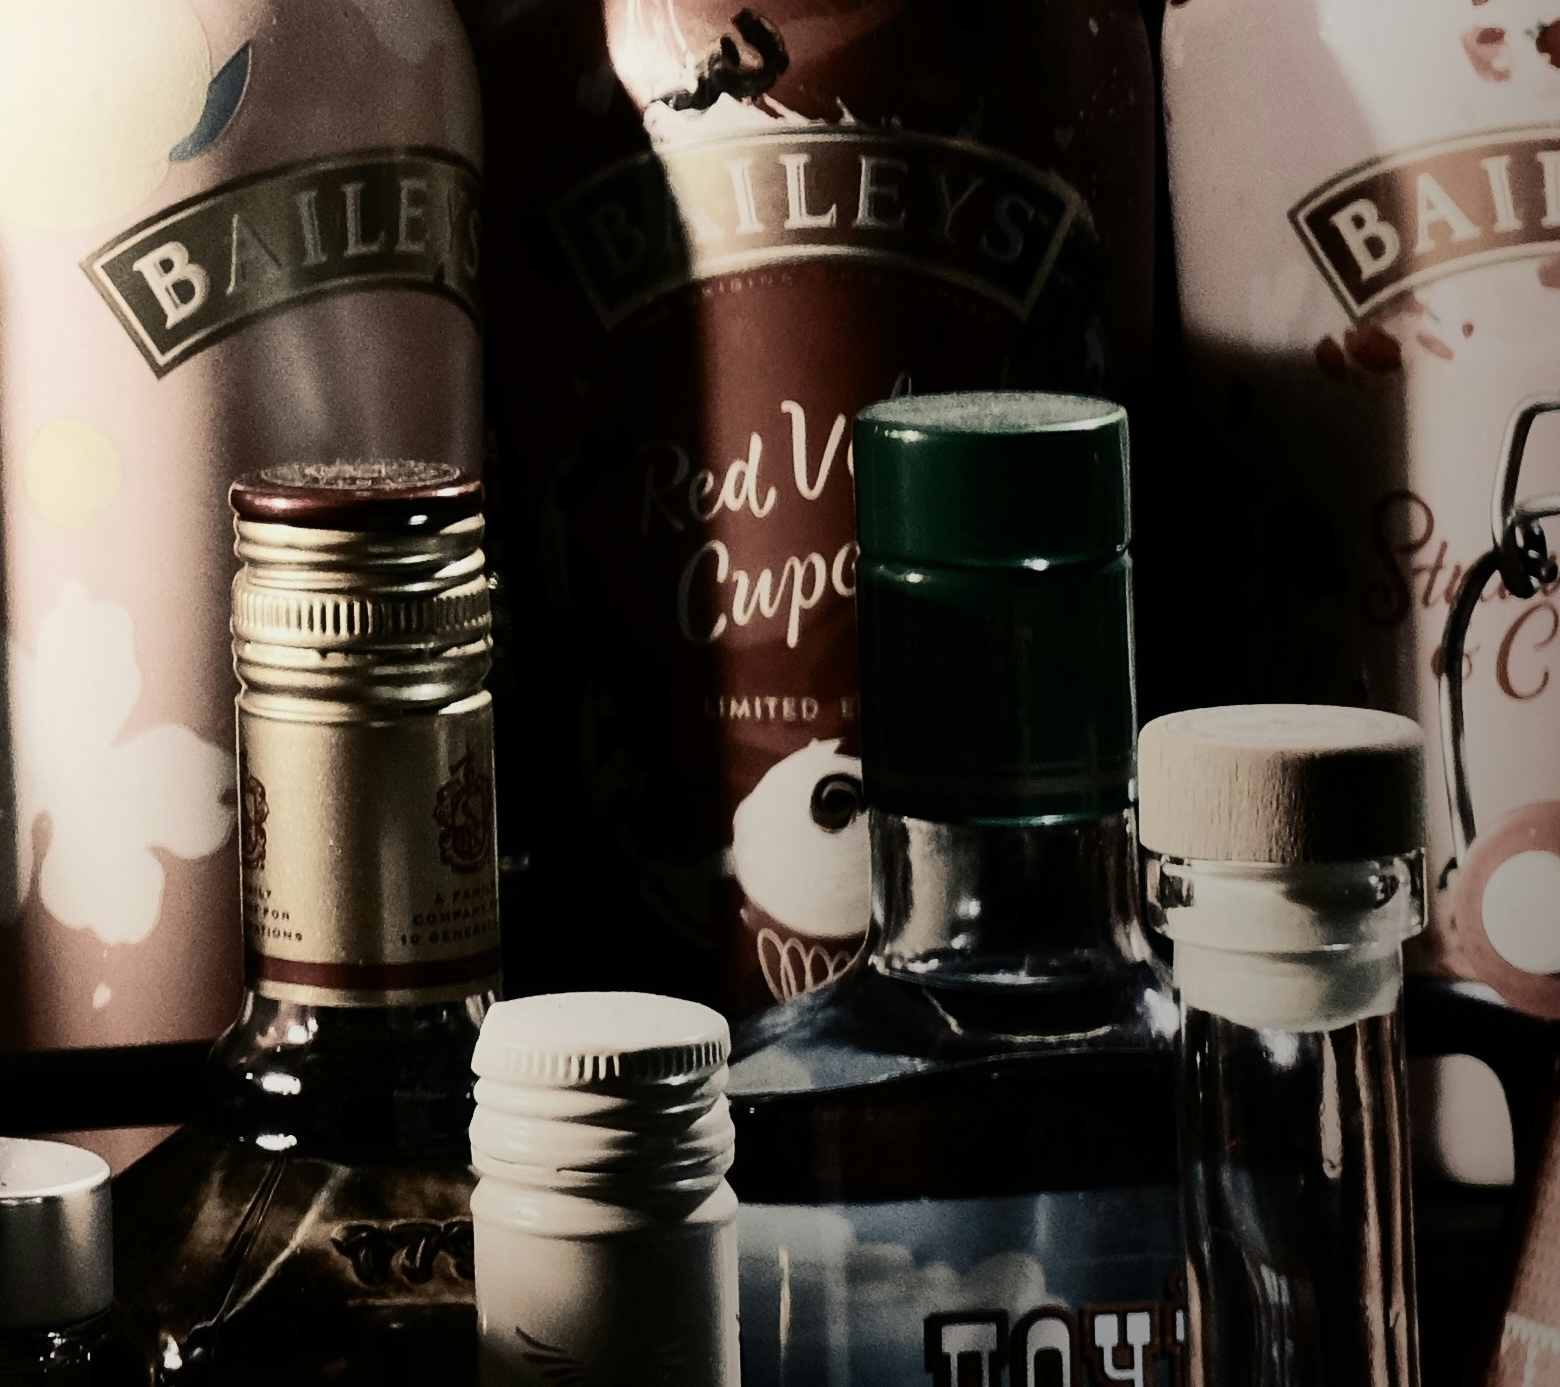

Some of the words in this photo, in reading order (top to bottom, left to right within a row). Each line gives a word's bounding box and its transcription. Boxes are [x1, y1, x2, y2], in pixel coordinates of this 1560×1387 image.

[584, 152, 1035, 280] BAILEYS
[637, 430, 778, 538] Red
[704, 695, 820, 723] LIMITED
